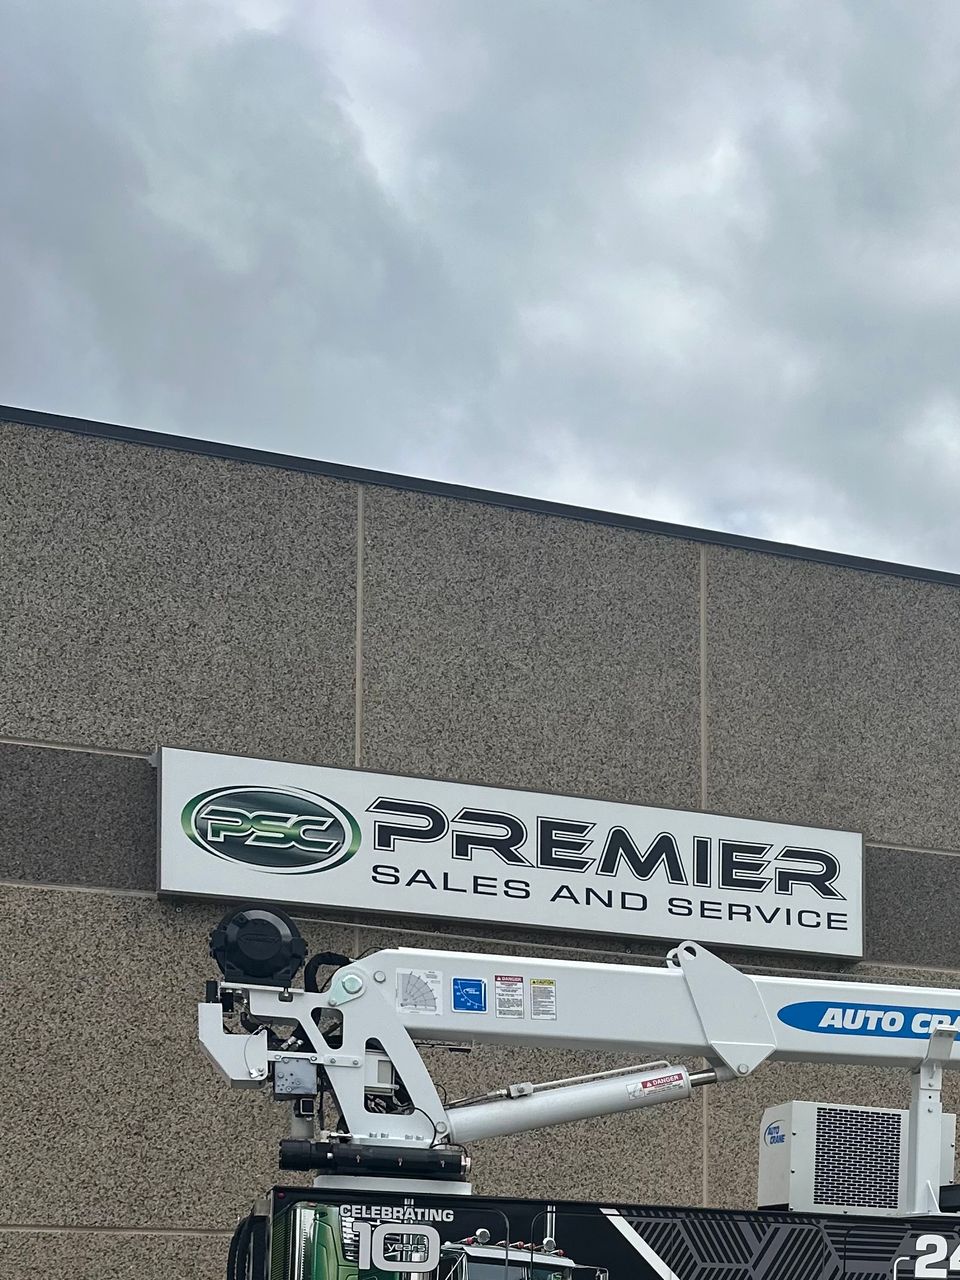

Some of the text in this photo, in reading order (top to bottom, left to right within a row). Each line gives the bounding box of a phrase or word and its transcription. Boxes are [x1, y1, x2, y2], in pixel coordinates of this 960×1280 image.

[200, 805, 340, 853] PSC
[365, 796, 848, 901] PREMIER
[370, 864, 848, 931] SALES AND SERVICE
[818, 1007, 905, 1033] AUTO
[652, 1075, 679, 1086] DANGER
[340, 1204, 454, 1222] CELEBRATING
[352, 1221, 440, 1272] 10
[387, 1243, 426, 1252] years
